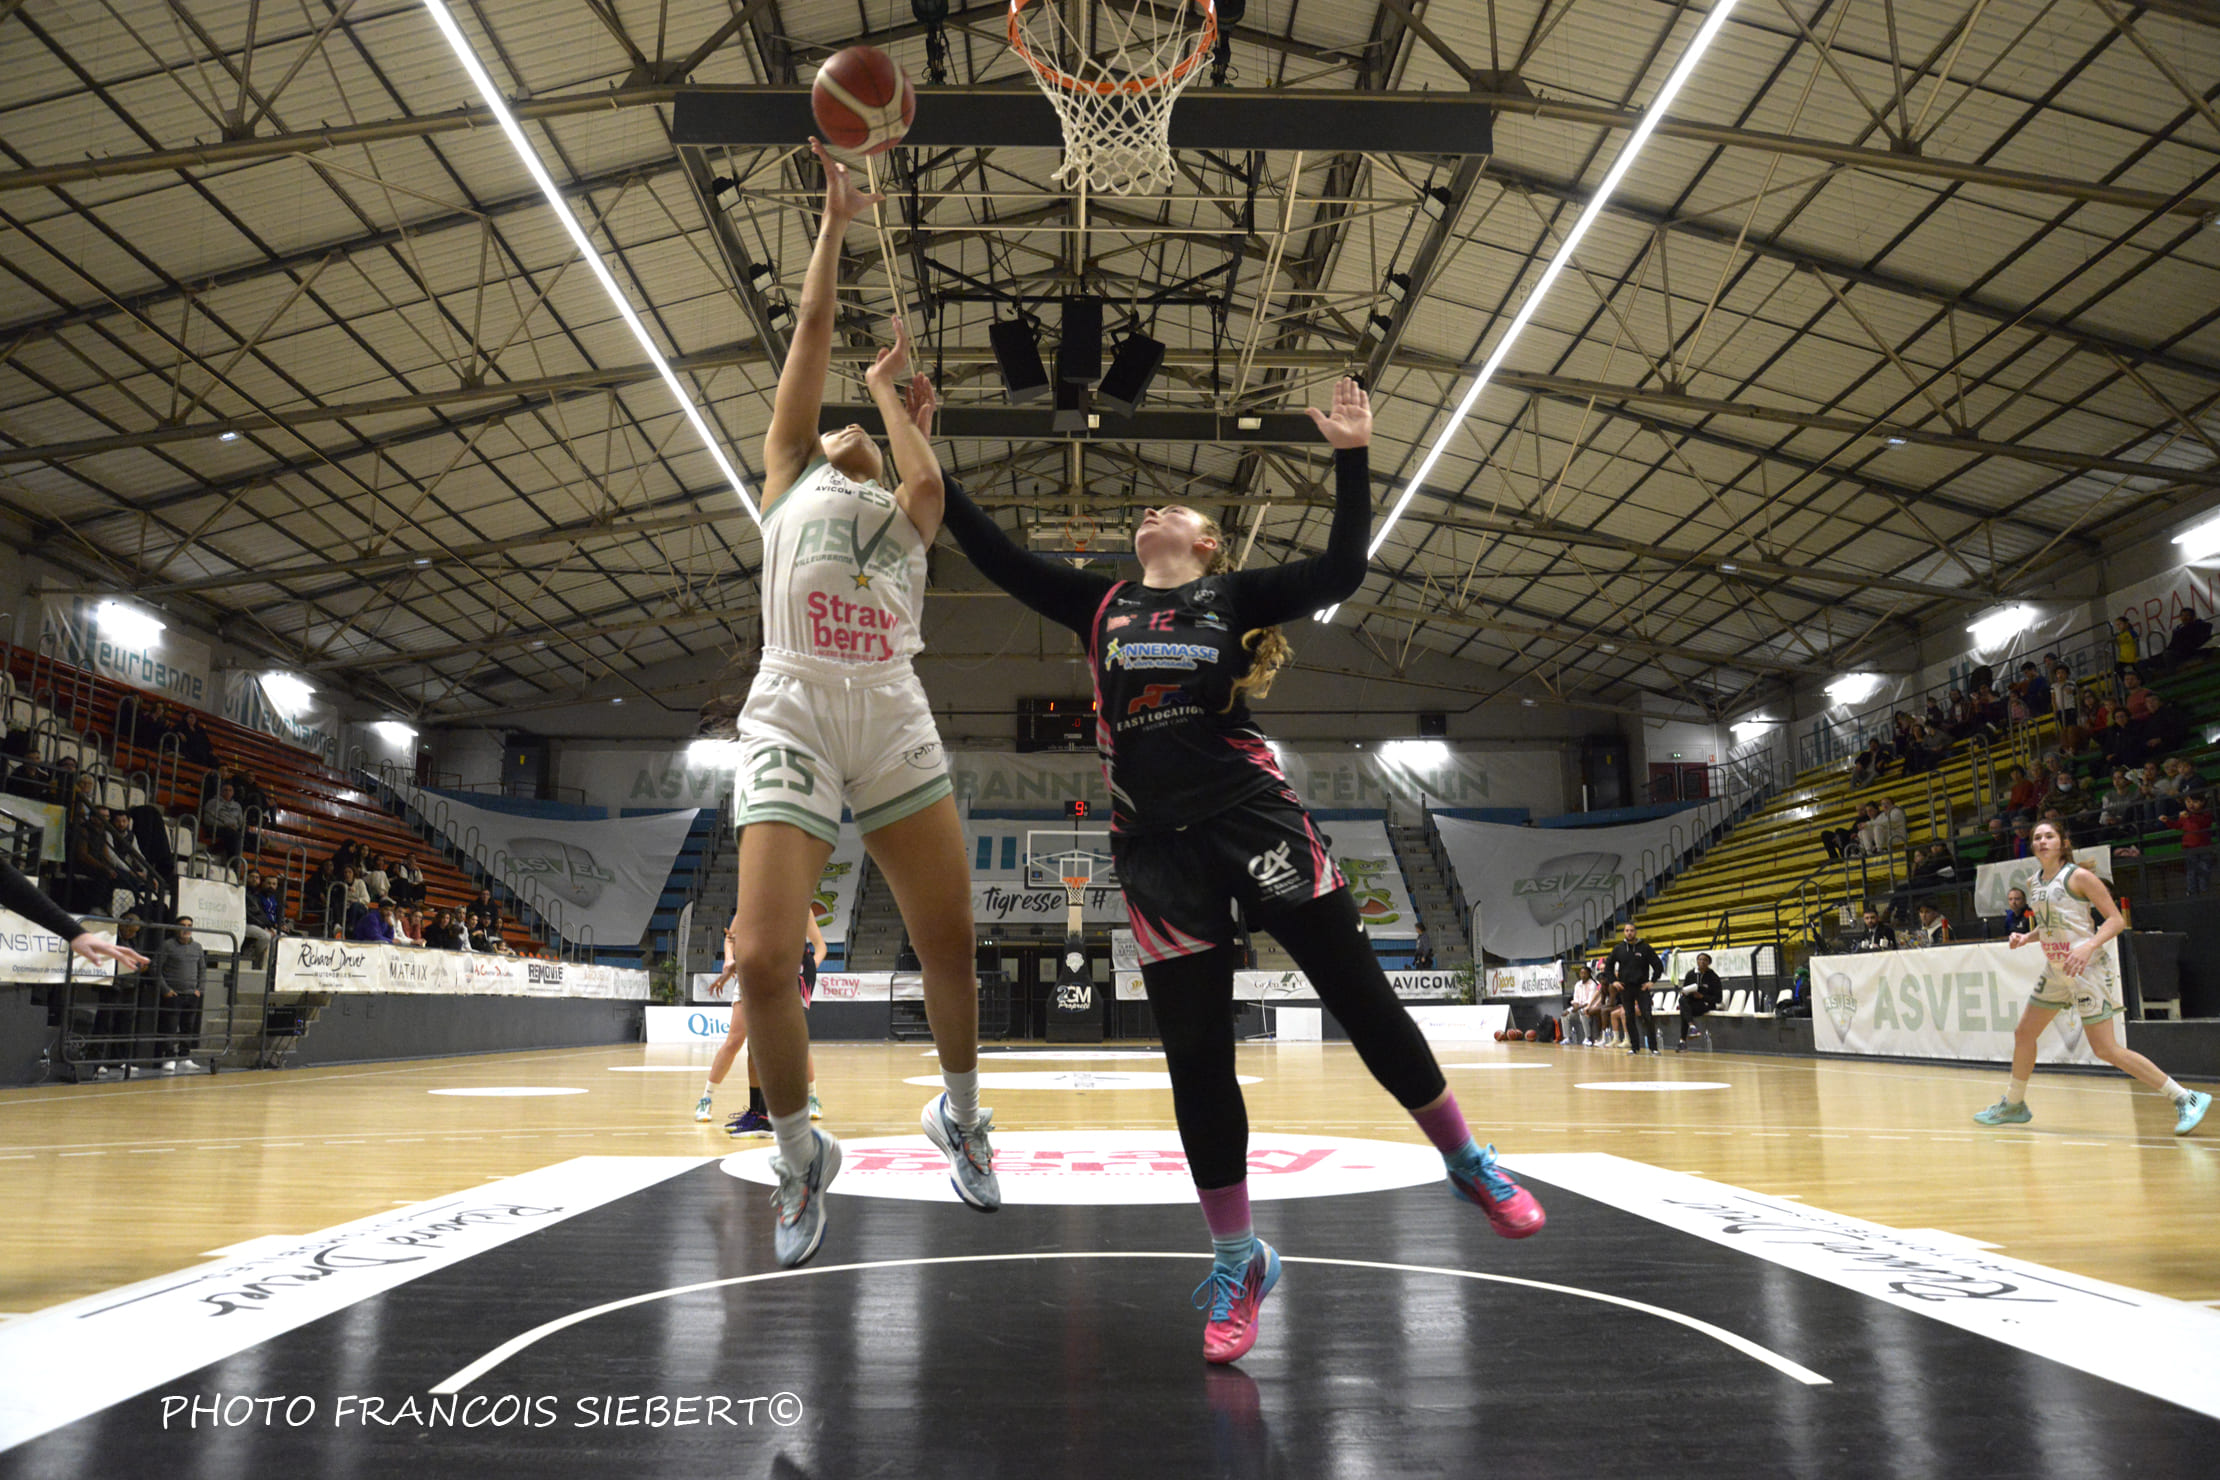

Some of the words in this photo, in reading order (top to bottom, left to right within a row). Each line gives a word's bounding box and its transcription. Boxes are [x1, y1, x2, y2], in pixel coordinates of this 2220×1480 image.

[815, 486, 852, 495] AVICOM
[858, 489, 891, 508] 25
[807, 591, 899, 631] Straw
[2122, 573, 2220, 638] GRAN
[1149, 609, 1176, 631] 12
[1117, 714, 1145, 732] EASY
[752, 745, 815, 796] 25
[1076, 801, 1084, 815] 9
[982, 887, 1063, 919] Tigresse
[297, 942, 335, 967] Richard
[390, 961, 428, 980] MATAIX
[1393, 976, 1457, 990] AVICOM
[1056, 985, 1092, 1003] 2GM
[1873, 970, 2019, 1033] ASVEL
